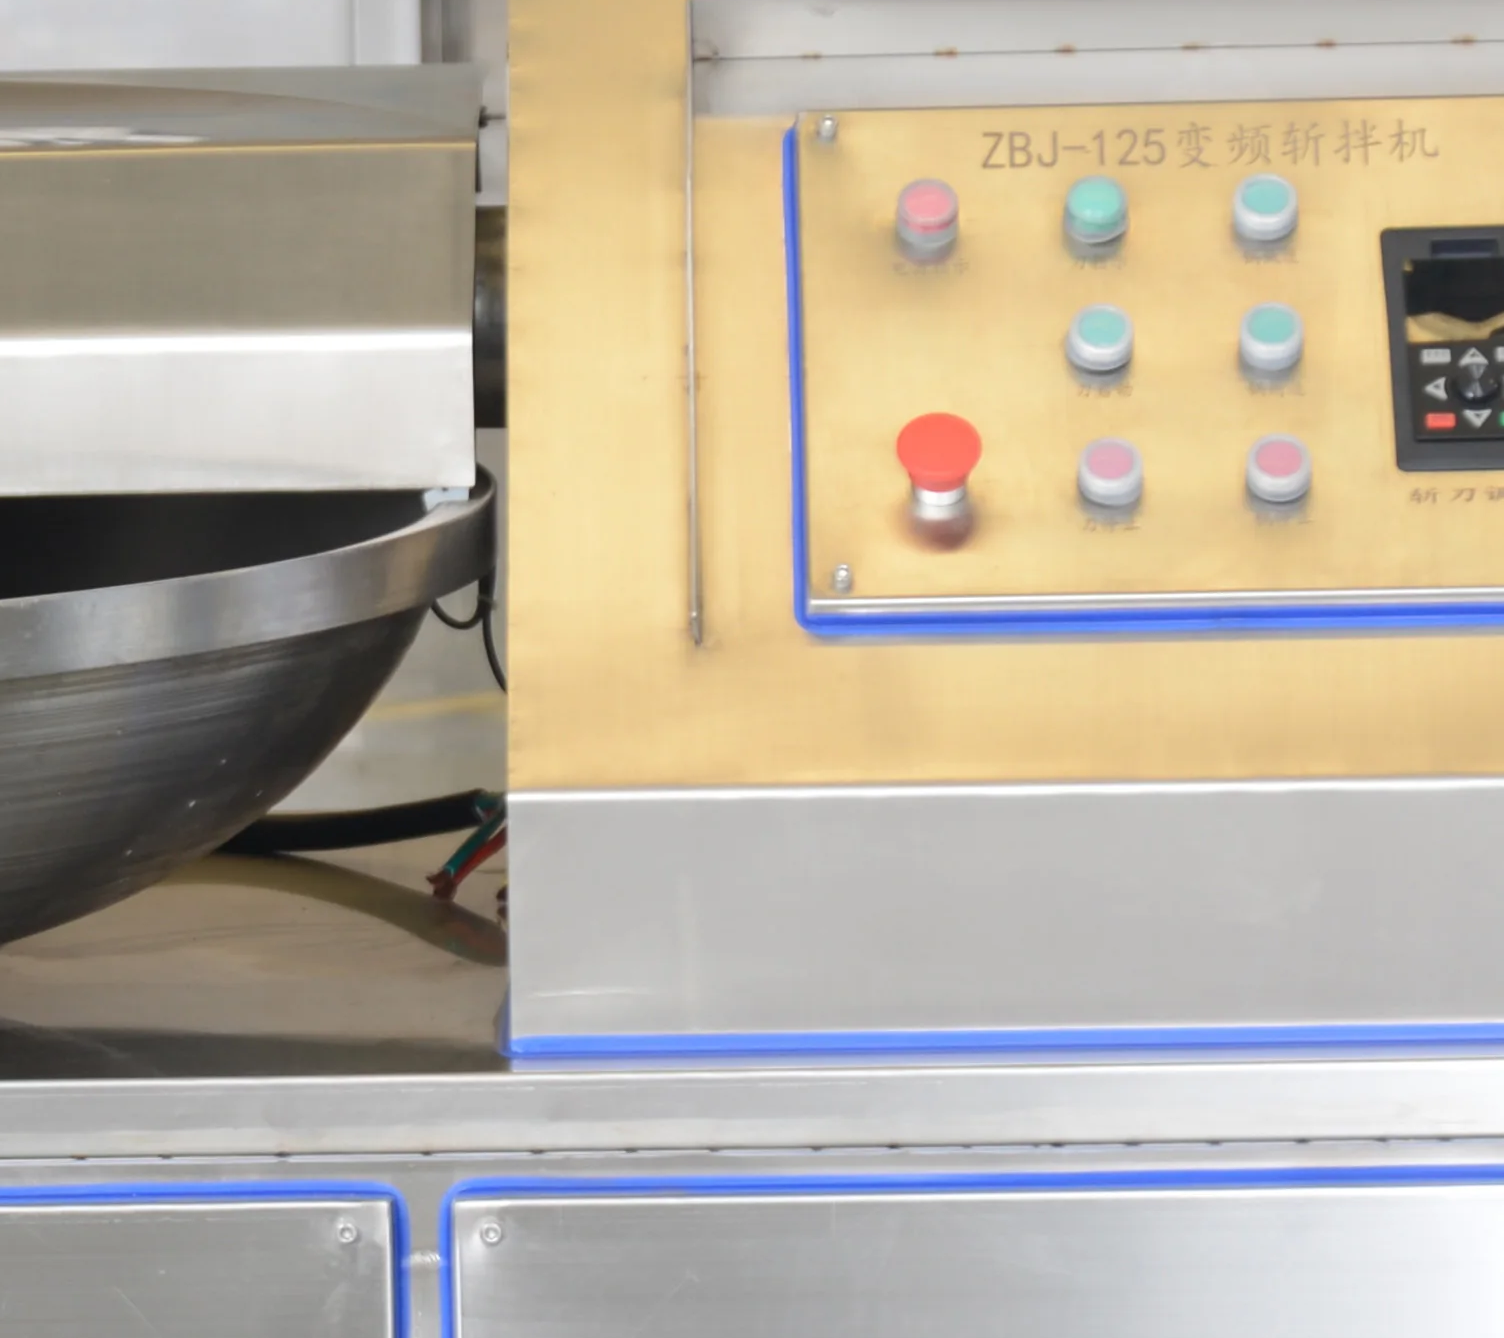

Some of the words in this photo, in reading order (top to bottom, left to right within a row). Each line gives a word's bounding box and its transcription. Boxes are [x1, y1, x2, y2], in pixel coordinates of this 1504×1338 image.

[980, 119, 1440, 169] ZBJ-125变频斩拌机
